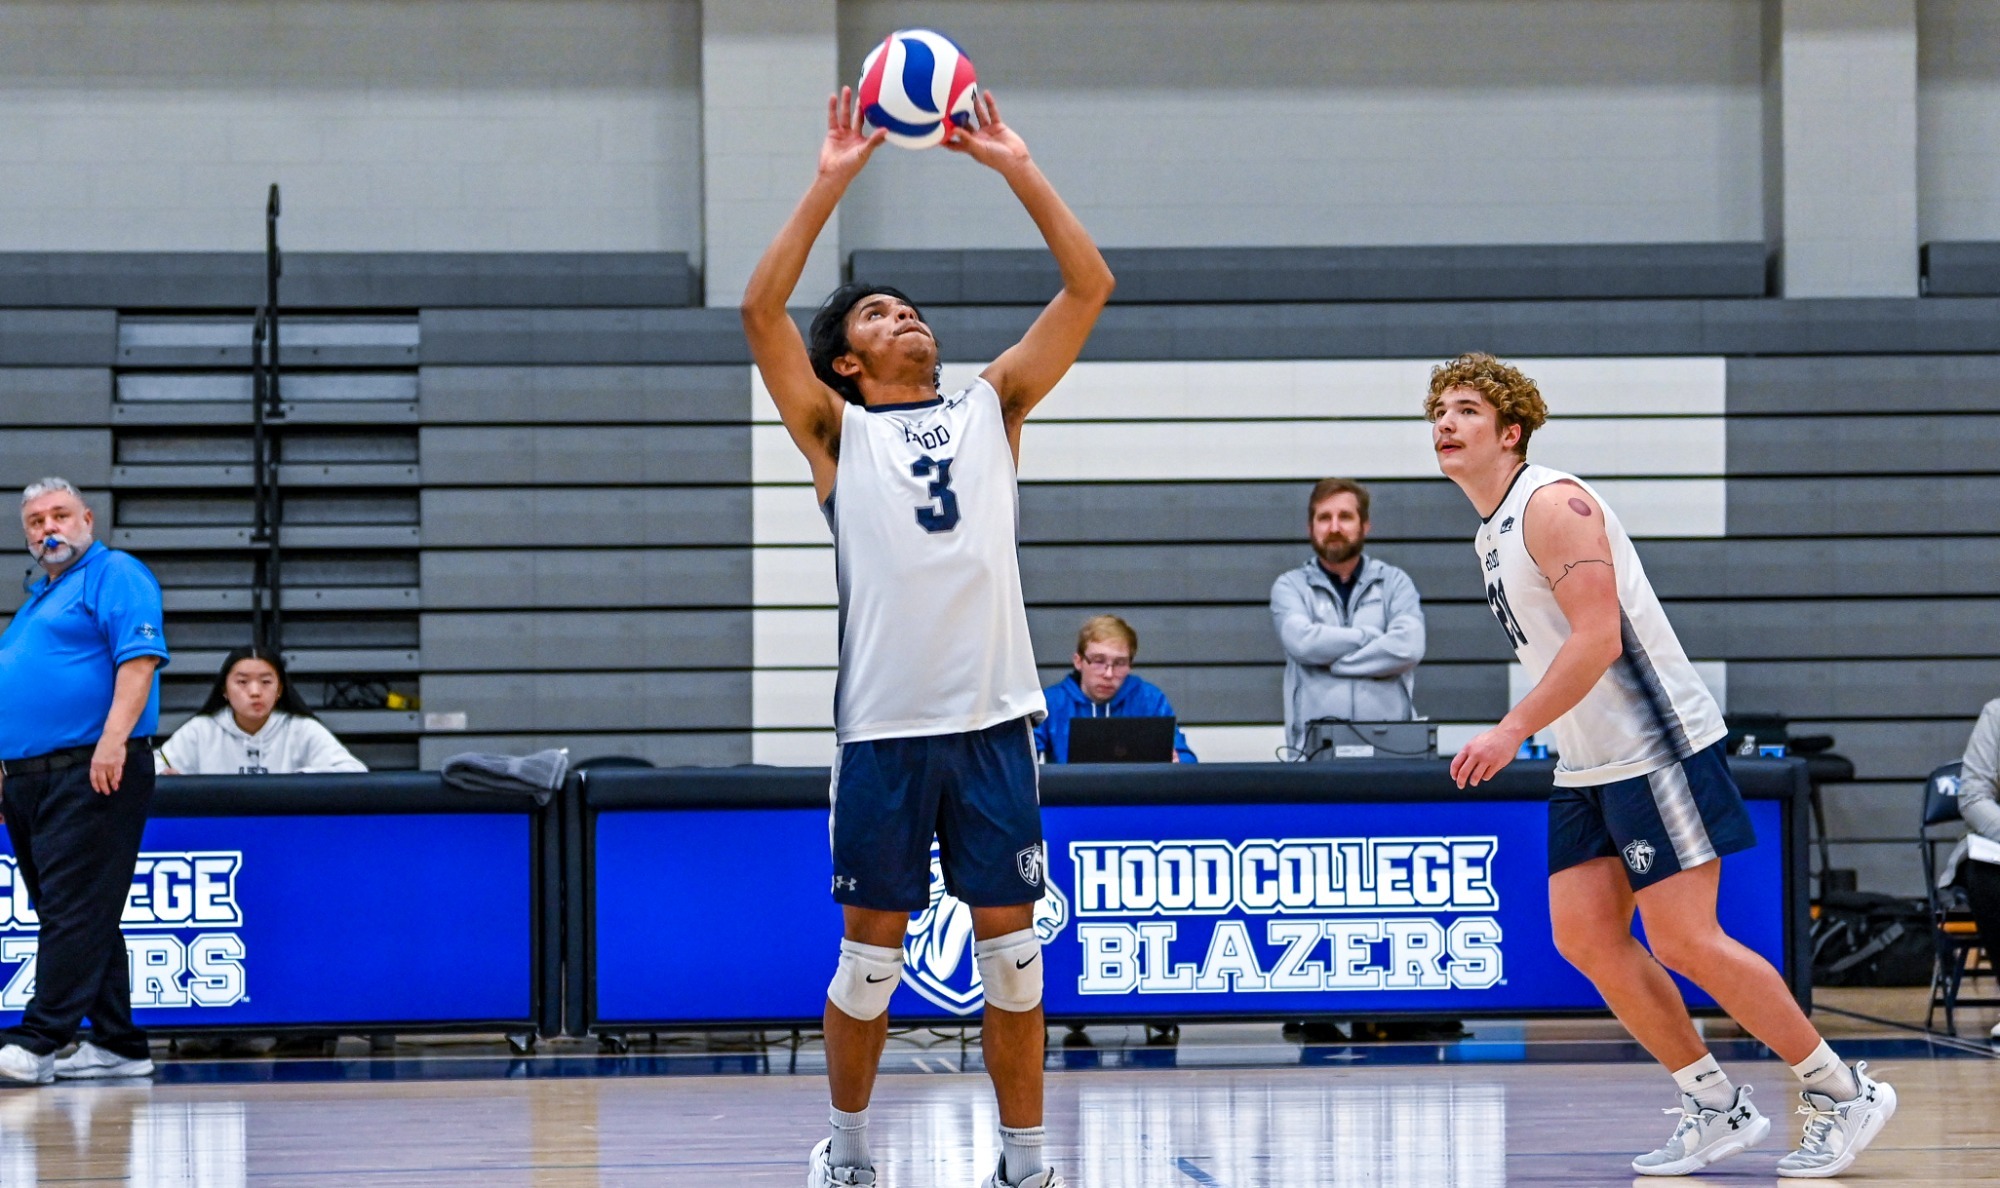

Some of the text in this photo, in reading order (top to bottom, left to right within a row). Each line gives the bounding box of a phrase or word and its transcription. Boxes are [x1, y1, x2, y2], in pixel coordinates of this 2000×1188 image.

[910, 453, 961, 534] 3
[1071, 837, 1498, 914] HOOD COLLEGE
[1078, 918, 1502, 994] BLAZERS
